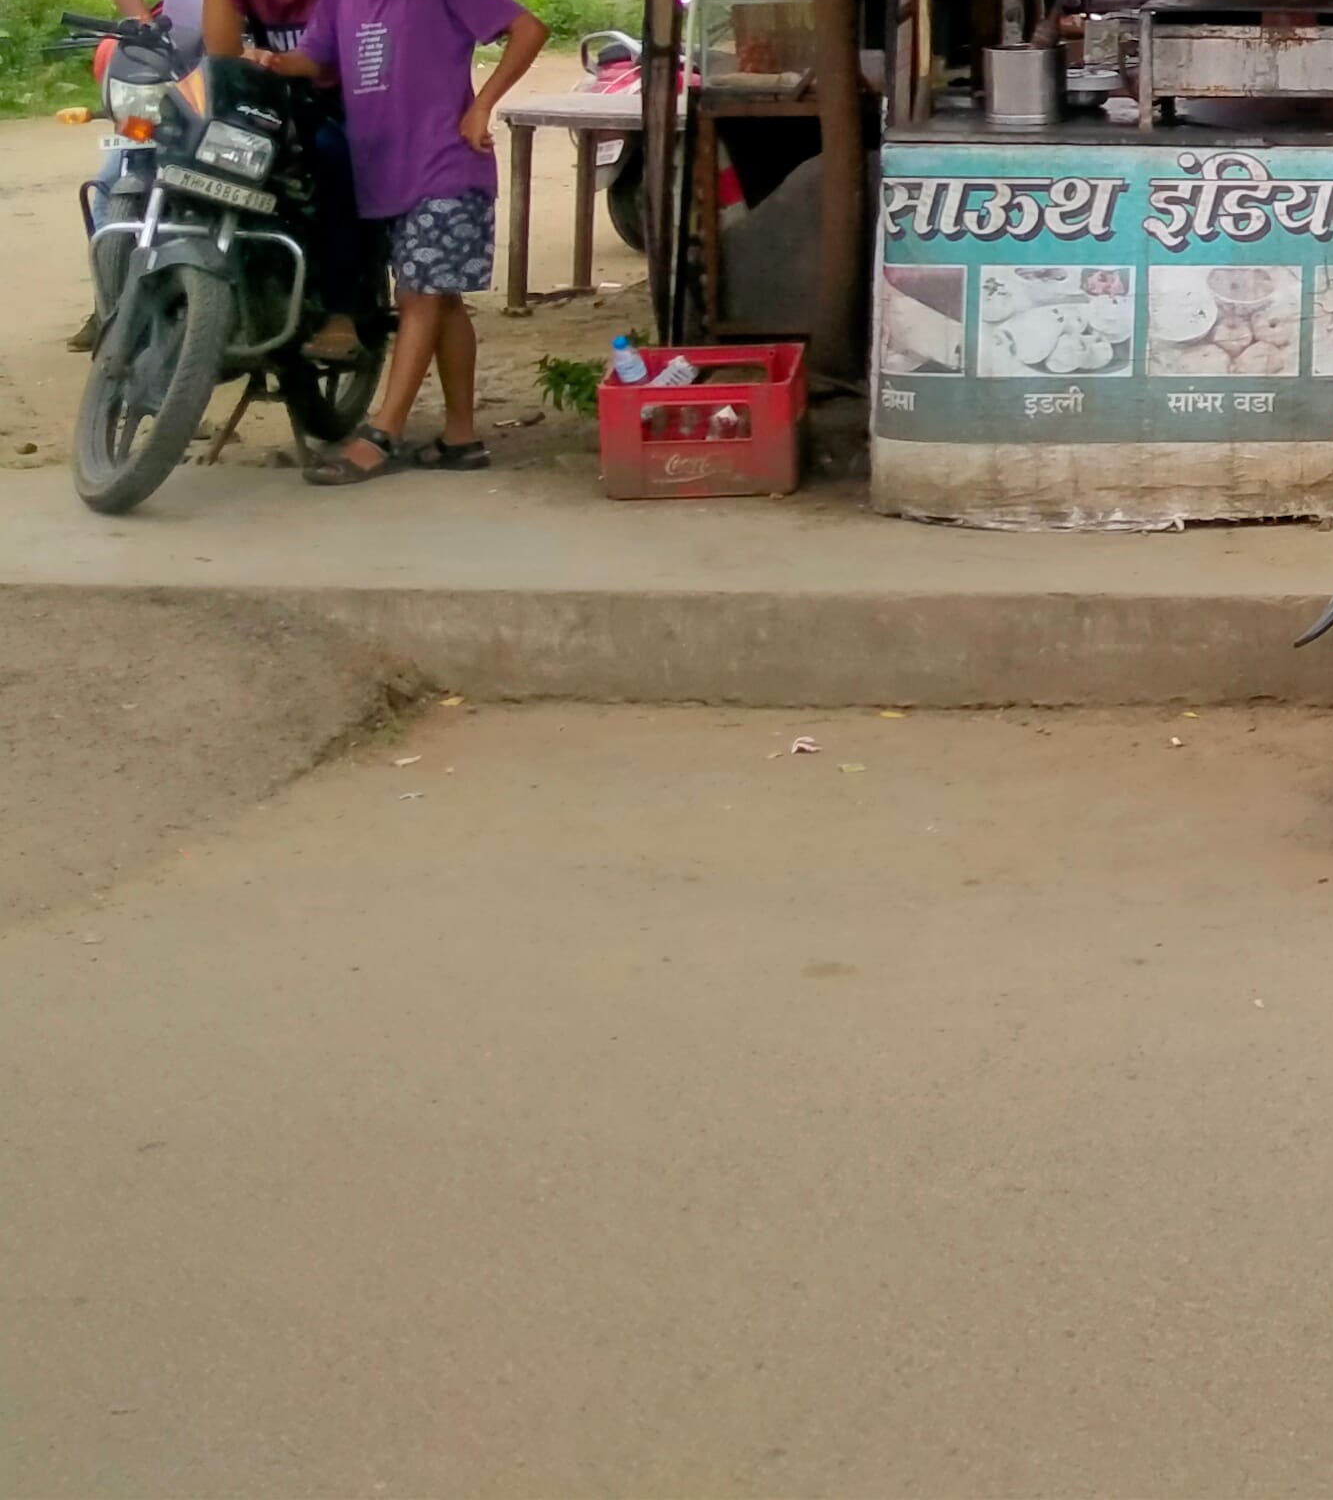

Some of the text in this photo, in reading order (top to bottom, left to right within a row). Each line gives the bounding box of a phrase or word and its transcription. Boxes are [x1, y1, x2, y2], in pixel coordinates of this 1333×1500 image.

[882, 176, 1131, 242] साऊथ
[1024, 386, 1084, 417] इडली
[1167, 384, 1276, 416] सांभर वडा
